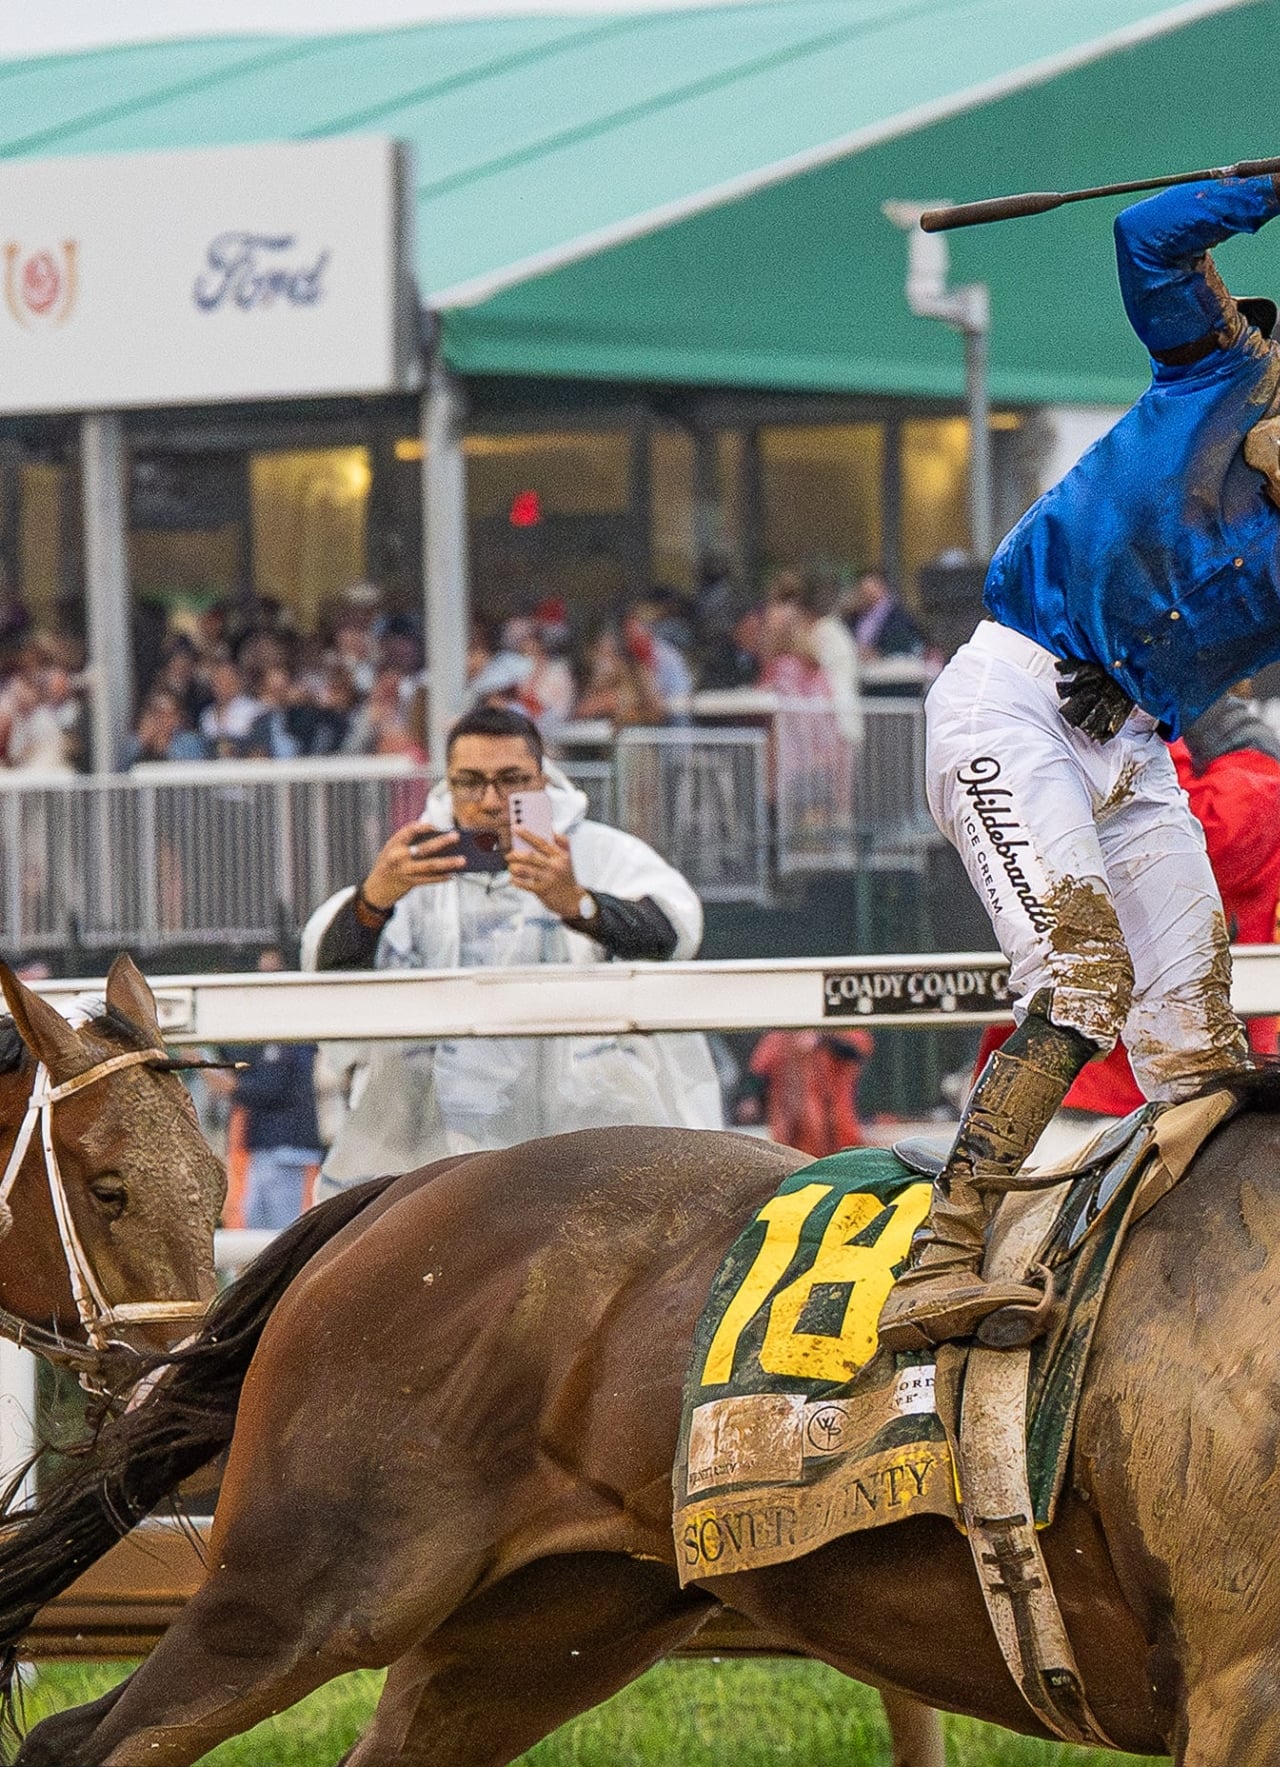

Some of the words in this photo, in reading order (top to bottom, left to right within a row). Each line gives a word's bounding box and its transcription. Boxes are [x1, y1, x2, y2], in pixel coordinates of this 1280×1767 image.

[192, 231, 331, 314] Ford
[957, 757, 1057, 934] Hildebrandt's
[964, 816, 980, 847] ICE
[977, 851, 1003, 914] CREAM
[825, 974, 906, 1006] COADY
[907, 971, 988, 1003] COADY
[701, 1183, 932, 1386] 18
